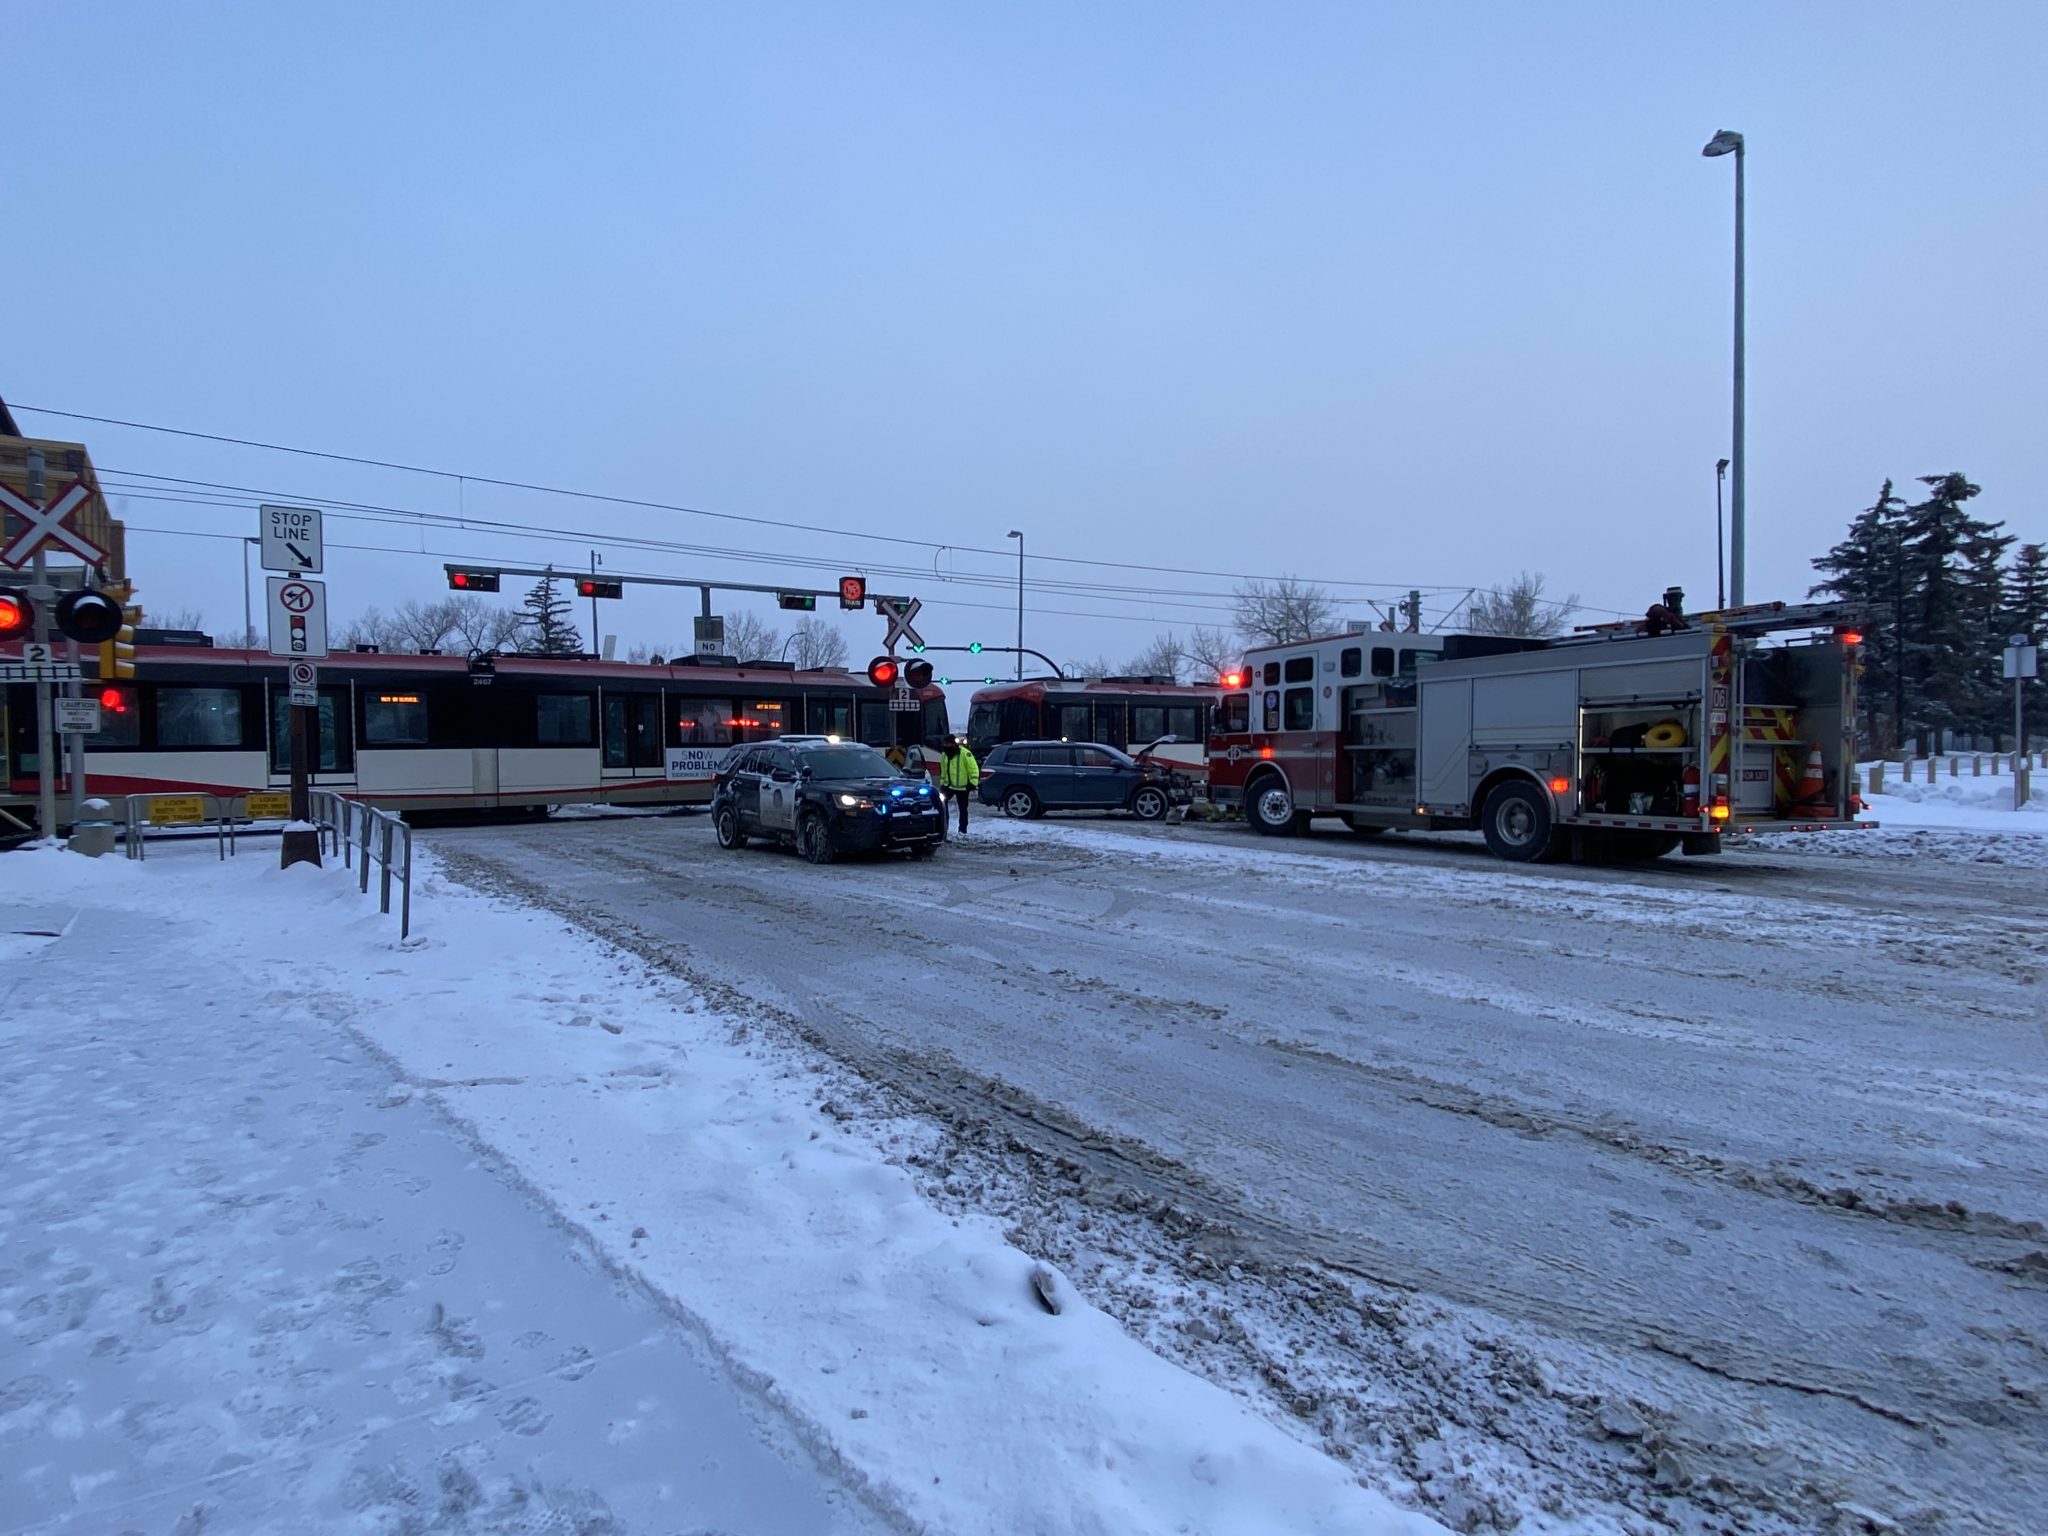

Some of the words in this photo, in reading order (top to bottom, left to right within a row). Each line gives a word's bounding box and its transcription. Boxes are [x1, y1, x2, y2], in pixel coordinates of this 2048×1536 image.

[271, 511, 312, 527] STOP
[273, 526, 311, 541] LINE
[702, 643, 716, 651] NO
[29, 645, 46, 662] 2
[901, 690, 908, 700] 2
[1713, 689, 1725, 708] 06
[60, 701, 97, 709] CAUTION
[681, 750, 713, 760] SNOW
